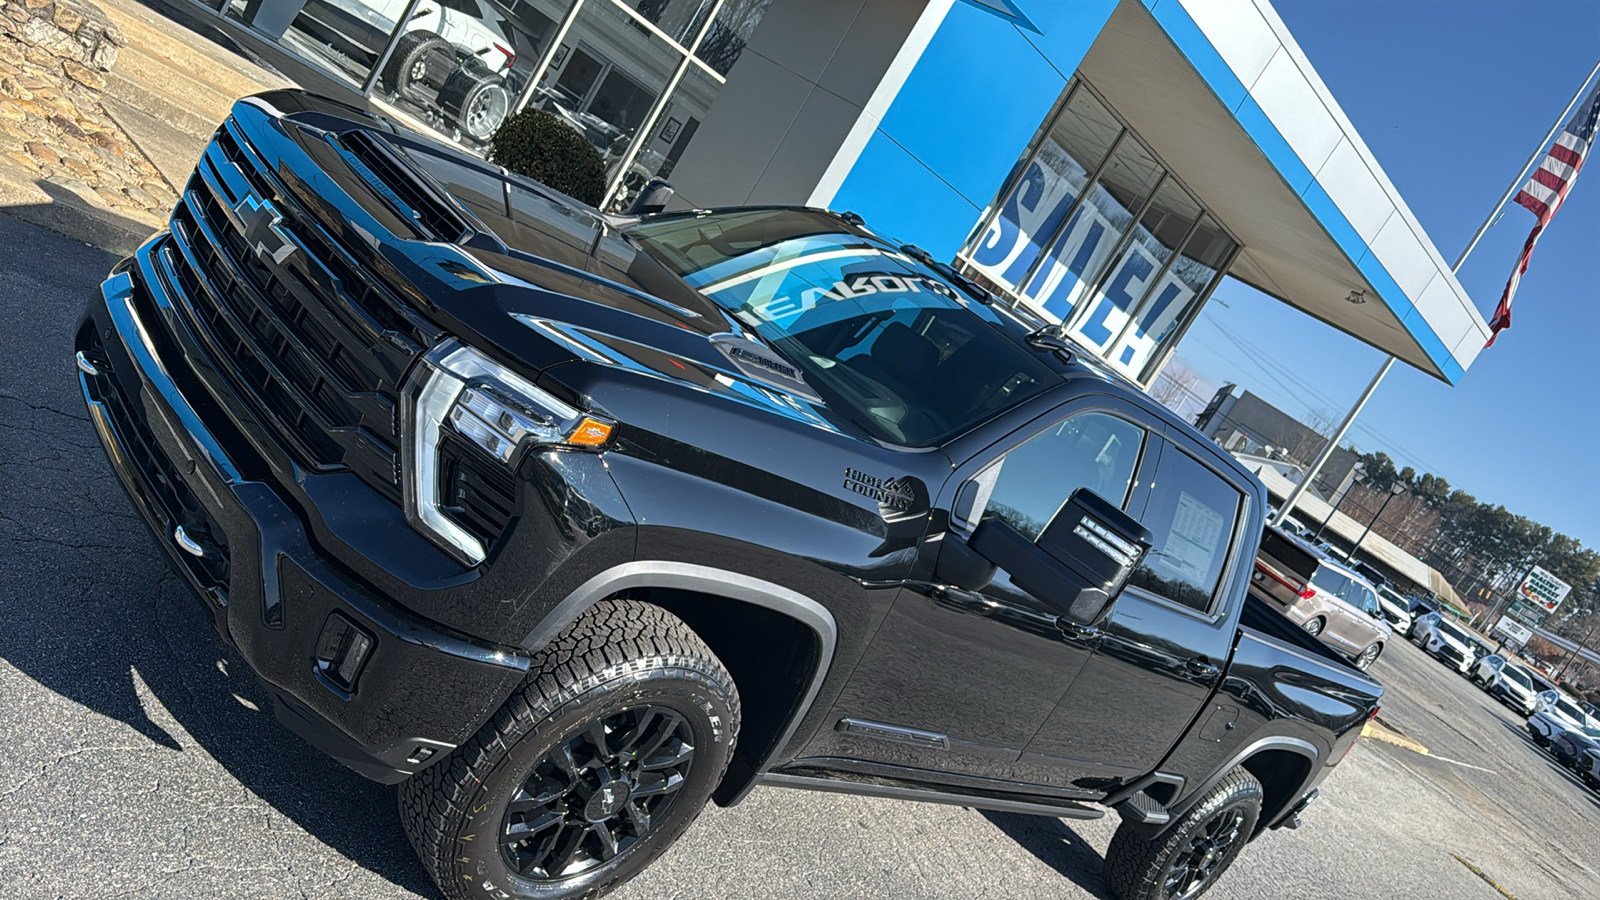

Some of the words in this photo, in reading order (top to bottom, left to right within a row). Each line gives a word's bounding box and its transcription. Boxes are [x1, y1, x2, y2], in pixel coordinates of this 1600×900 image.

[347, 155, 404, 208] CHEVROLET
[972, 161, 1183, 366] SALE!
[845, 467, 885, 489] HIGH
[842, 478, 914, 511] COUNTRY
[1529, 578, 1560, 599] HARVEST
[1530, 571, 1559, 591] HEALTHY
[1527, 585, 1559, 606] PRODUCE
